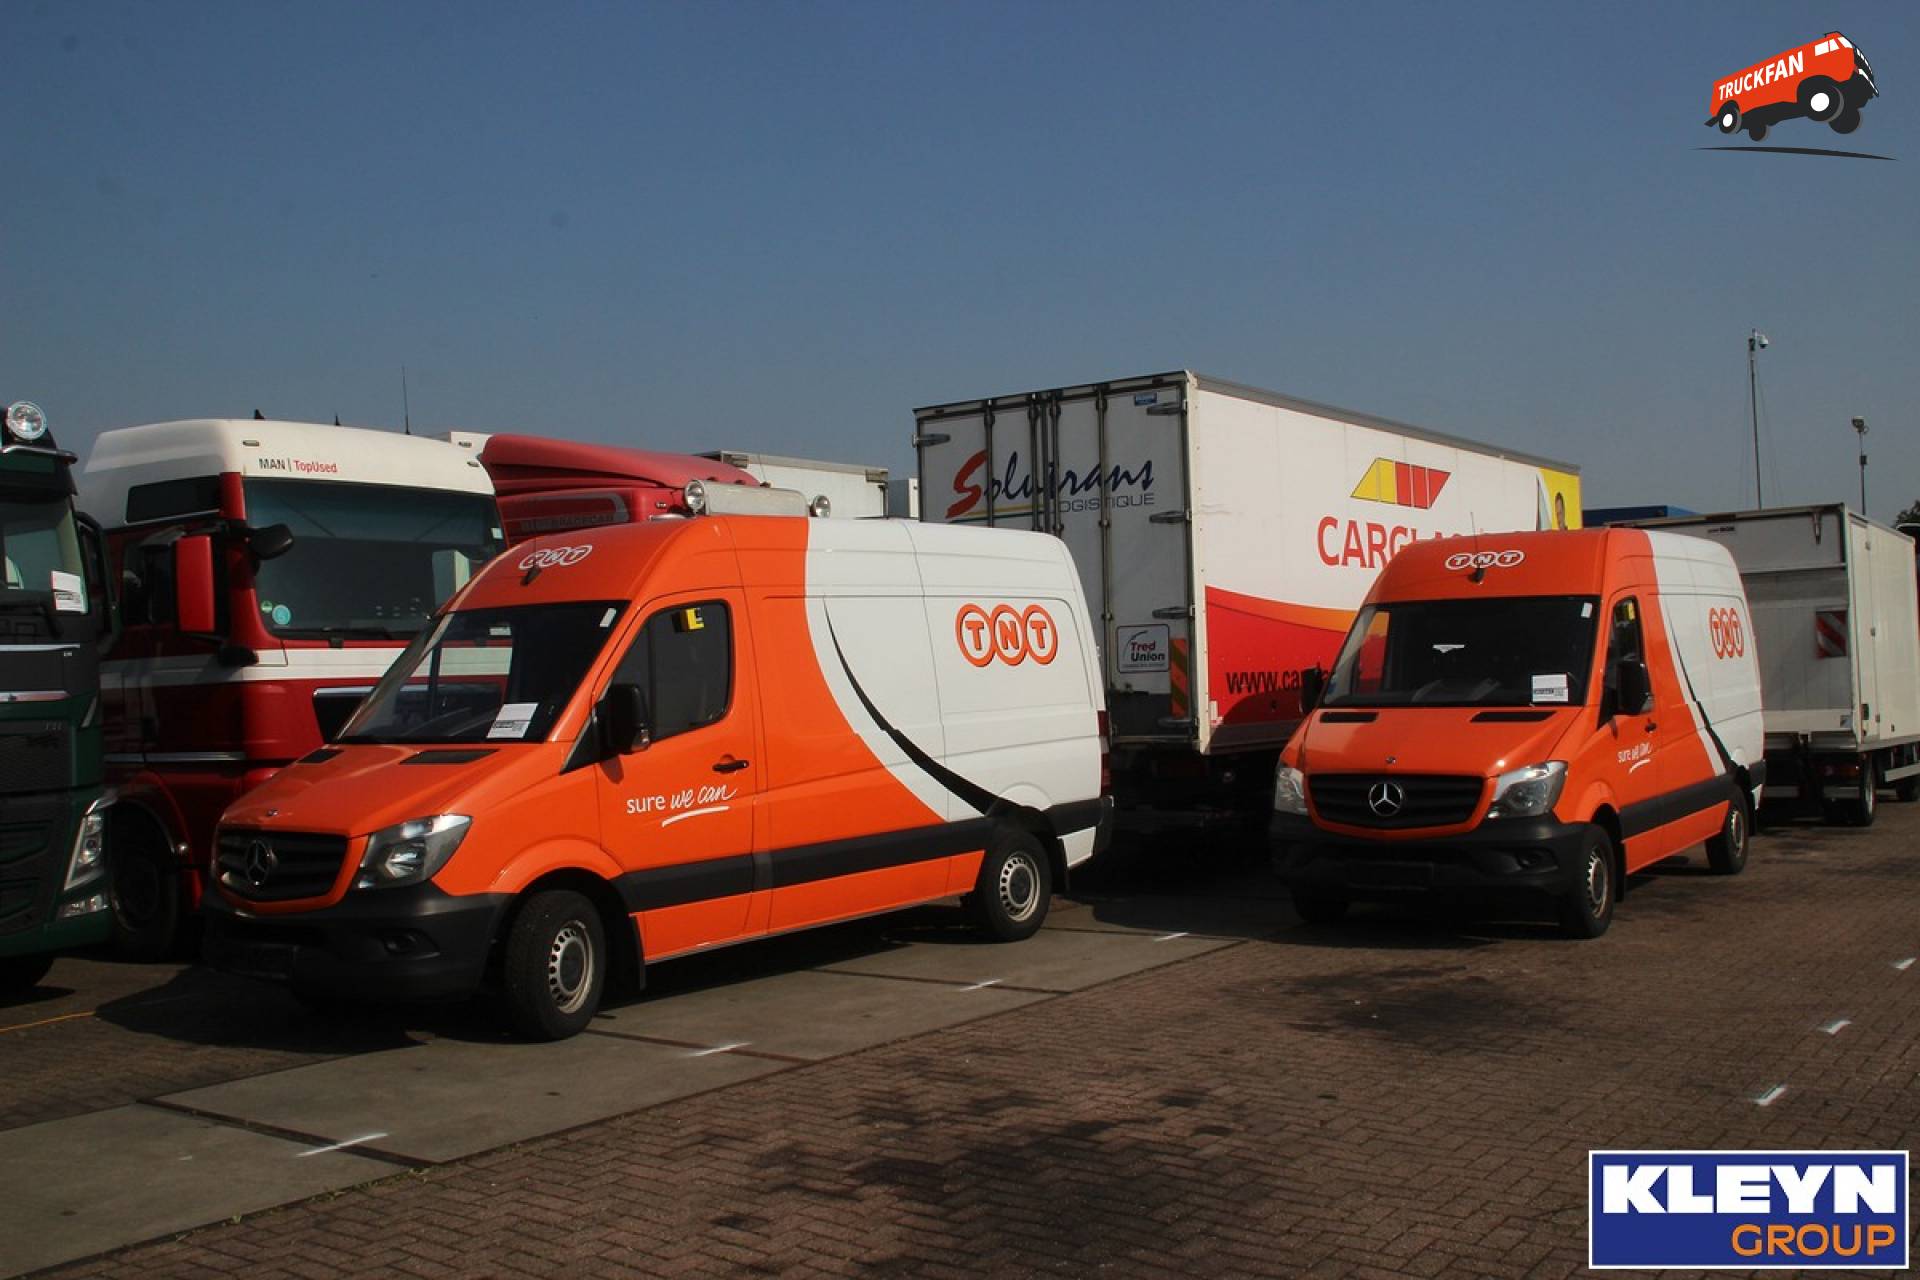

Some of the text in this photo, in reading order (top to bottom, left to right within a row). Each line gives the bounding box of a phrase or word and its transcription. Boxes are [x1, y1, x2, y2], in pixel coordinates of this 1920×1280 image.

[258, 458, 338, 473] MAN TopUsed
[1055, 492, 1155, 513] OGISIQUE
[1131, 652, 1166, 662] Union
[626, 784, 738, 814] sure we can
